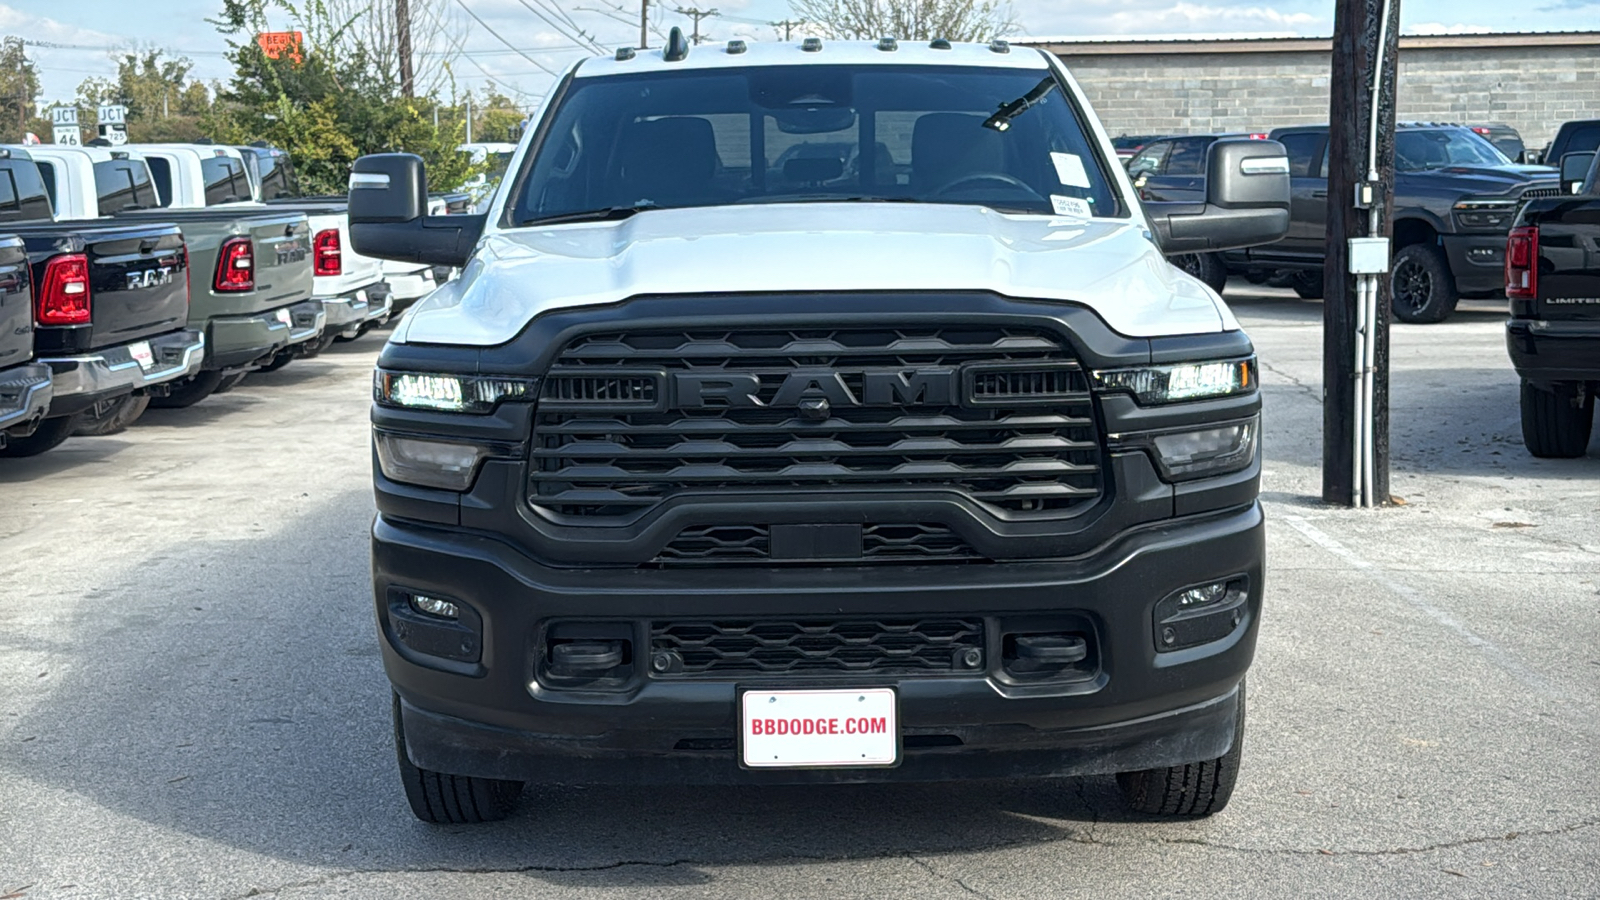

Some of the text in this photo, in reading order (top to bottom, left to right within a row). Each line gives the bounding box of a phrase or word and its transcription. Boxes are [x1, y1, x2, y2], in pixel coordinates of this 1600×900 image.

[55, 110, 75, 122] JCT
[97, 109, 121, 121] JCT
[59, 134, 77, 146] 46
[109, 133, 125, 141] 725
[673, 371, 955, 407] RAM
[751, 717, 887, 735] BBDODGE.COM
